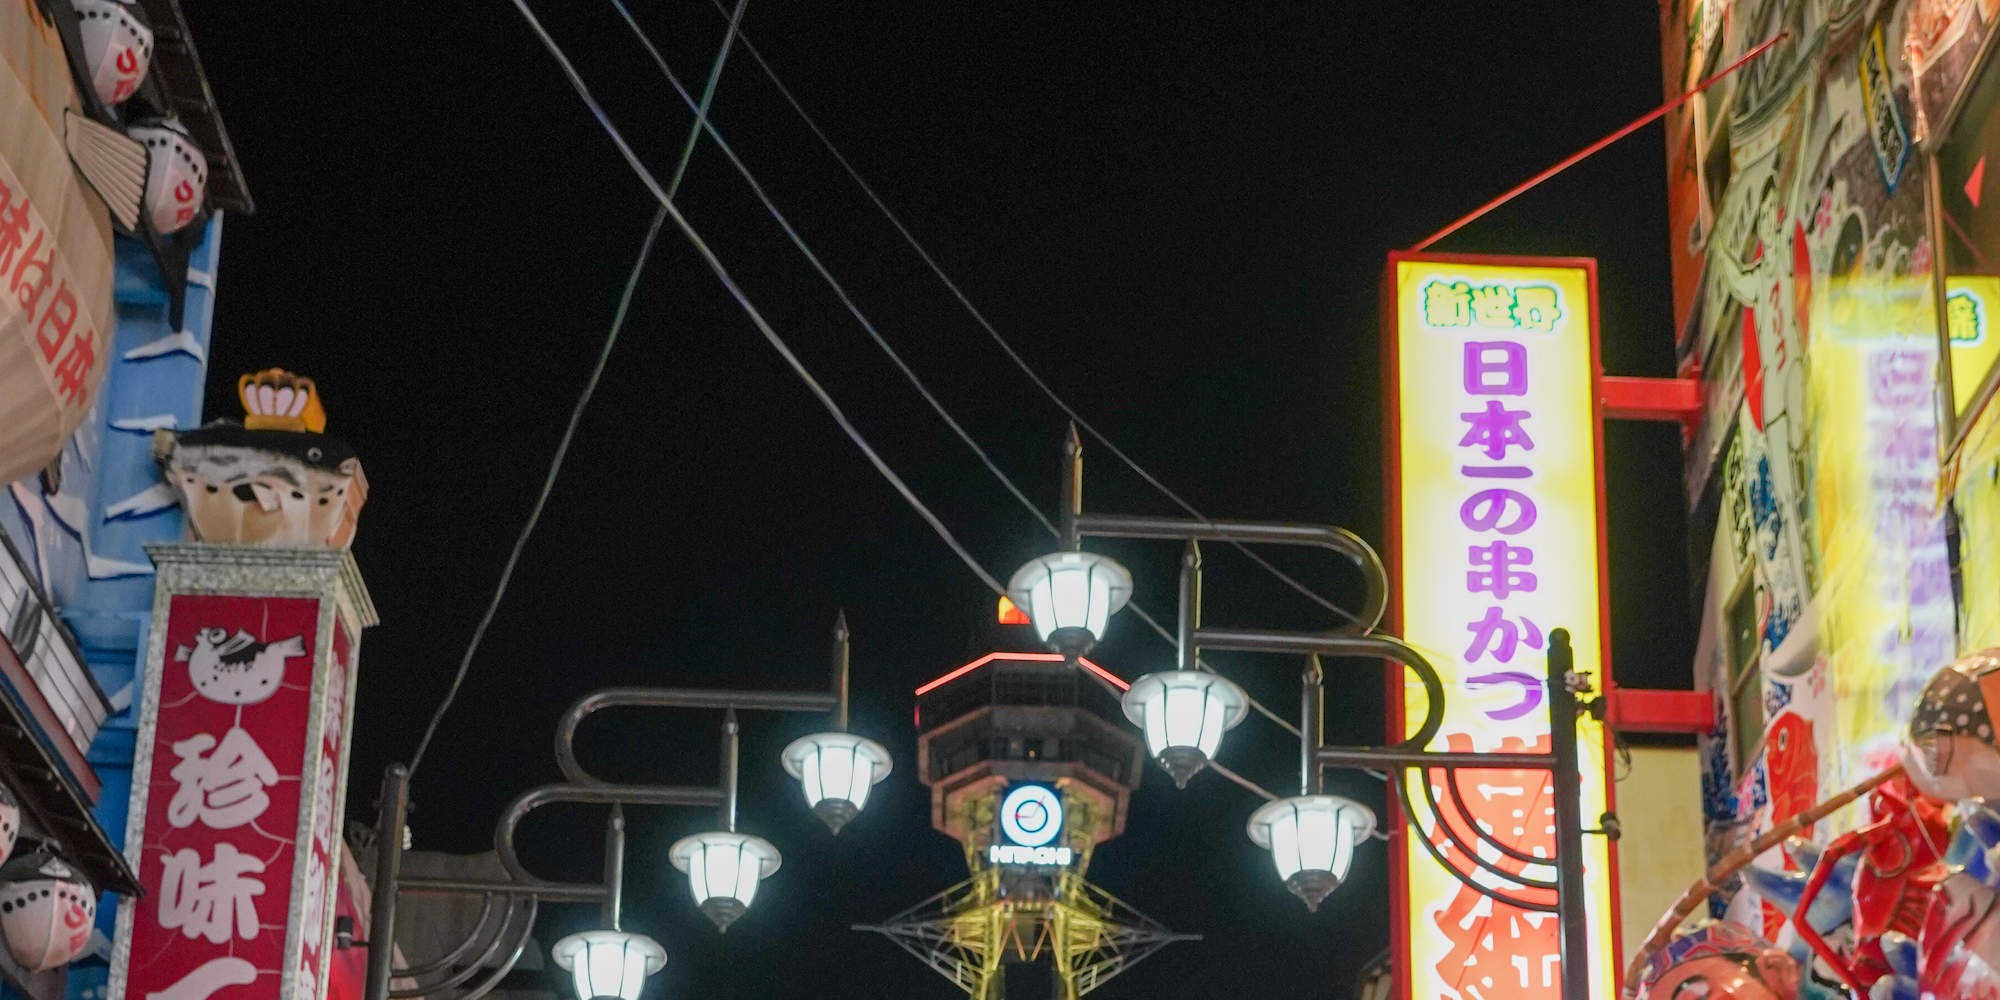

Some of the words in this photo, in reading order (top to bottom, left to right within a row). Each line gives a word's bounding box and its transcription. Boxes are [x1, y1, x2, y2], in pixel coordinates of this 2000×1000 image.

[1458, 340, 1544, 721] 日本一の串かつ
[990, 845, 1071, 866] HITACHI
